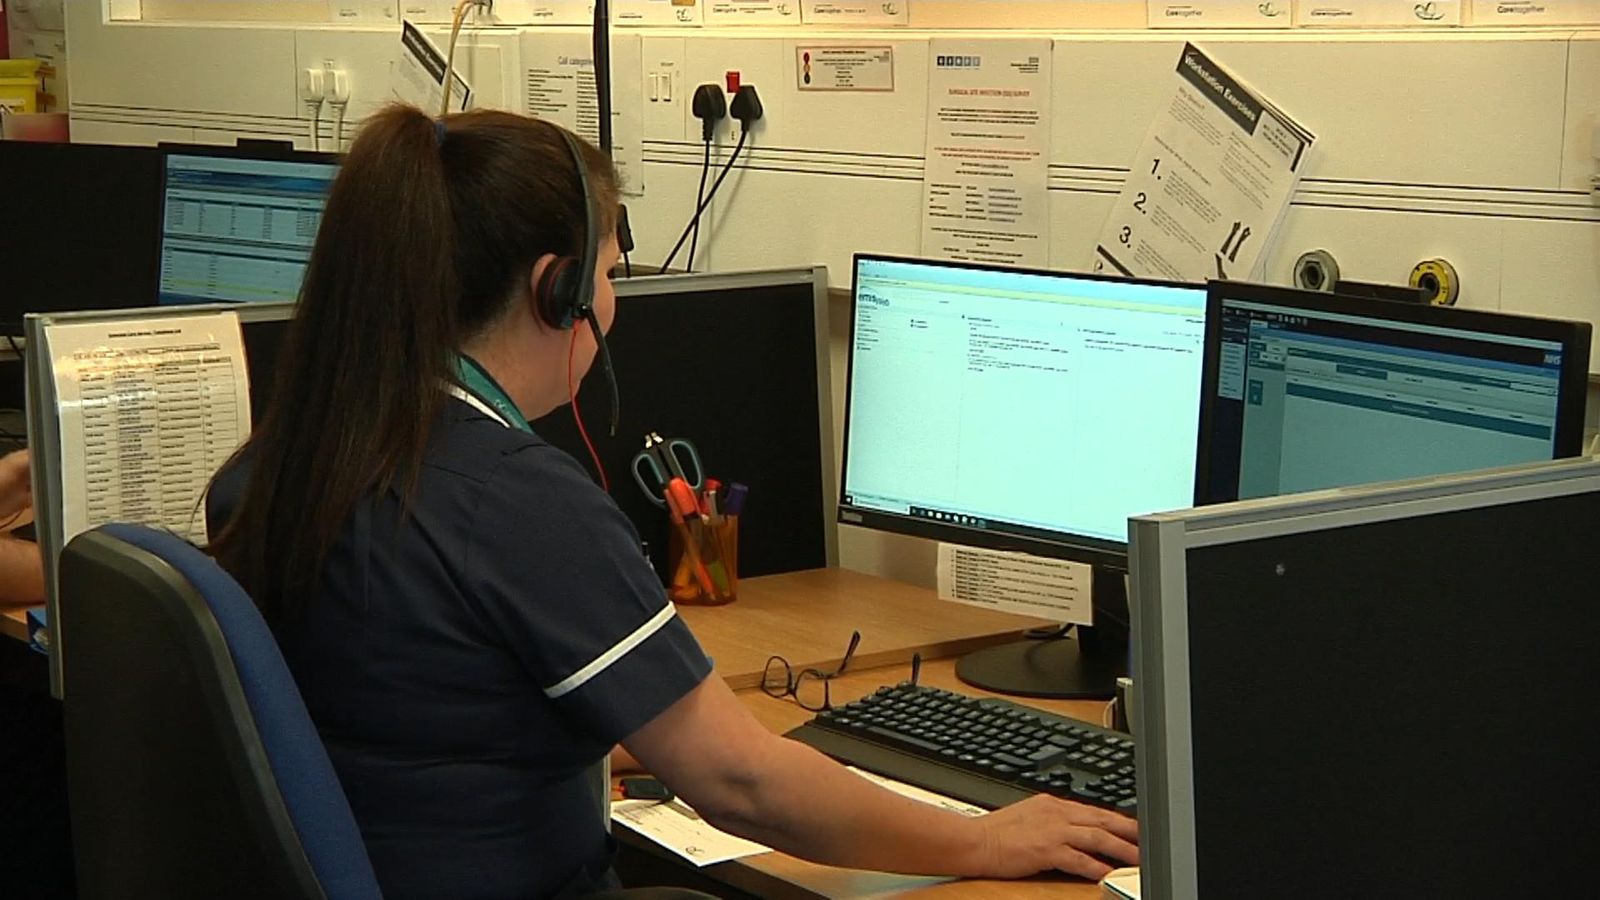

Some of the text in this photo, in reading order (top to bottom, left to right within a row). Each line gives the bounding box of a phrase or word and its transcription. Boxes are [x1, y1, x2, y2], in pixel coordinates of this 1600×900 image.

[1185, 54, 1257, 121] Workstation Exercises
[1151, 158, 1161, 180] 1.
[1133, 192, 1147, 214] 2.
[1119, 226, 1132, 249] 3.
